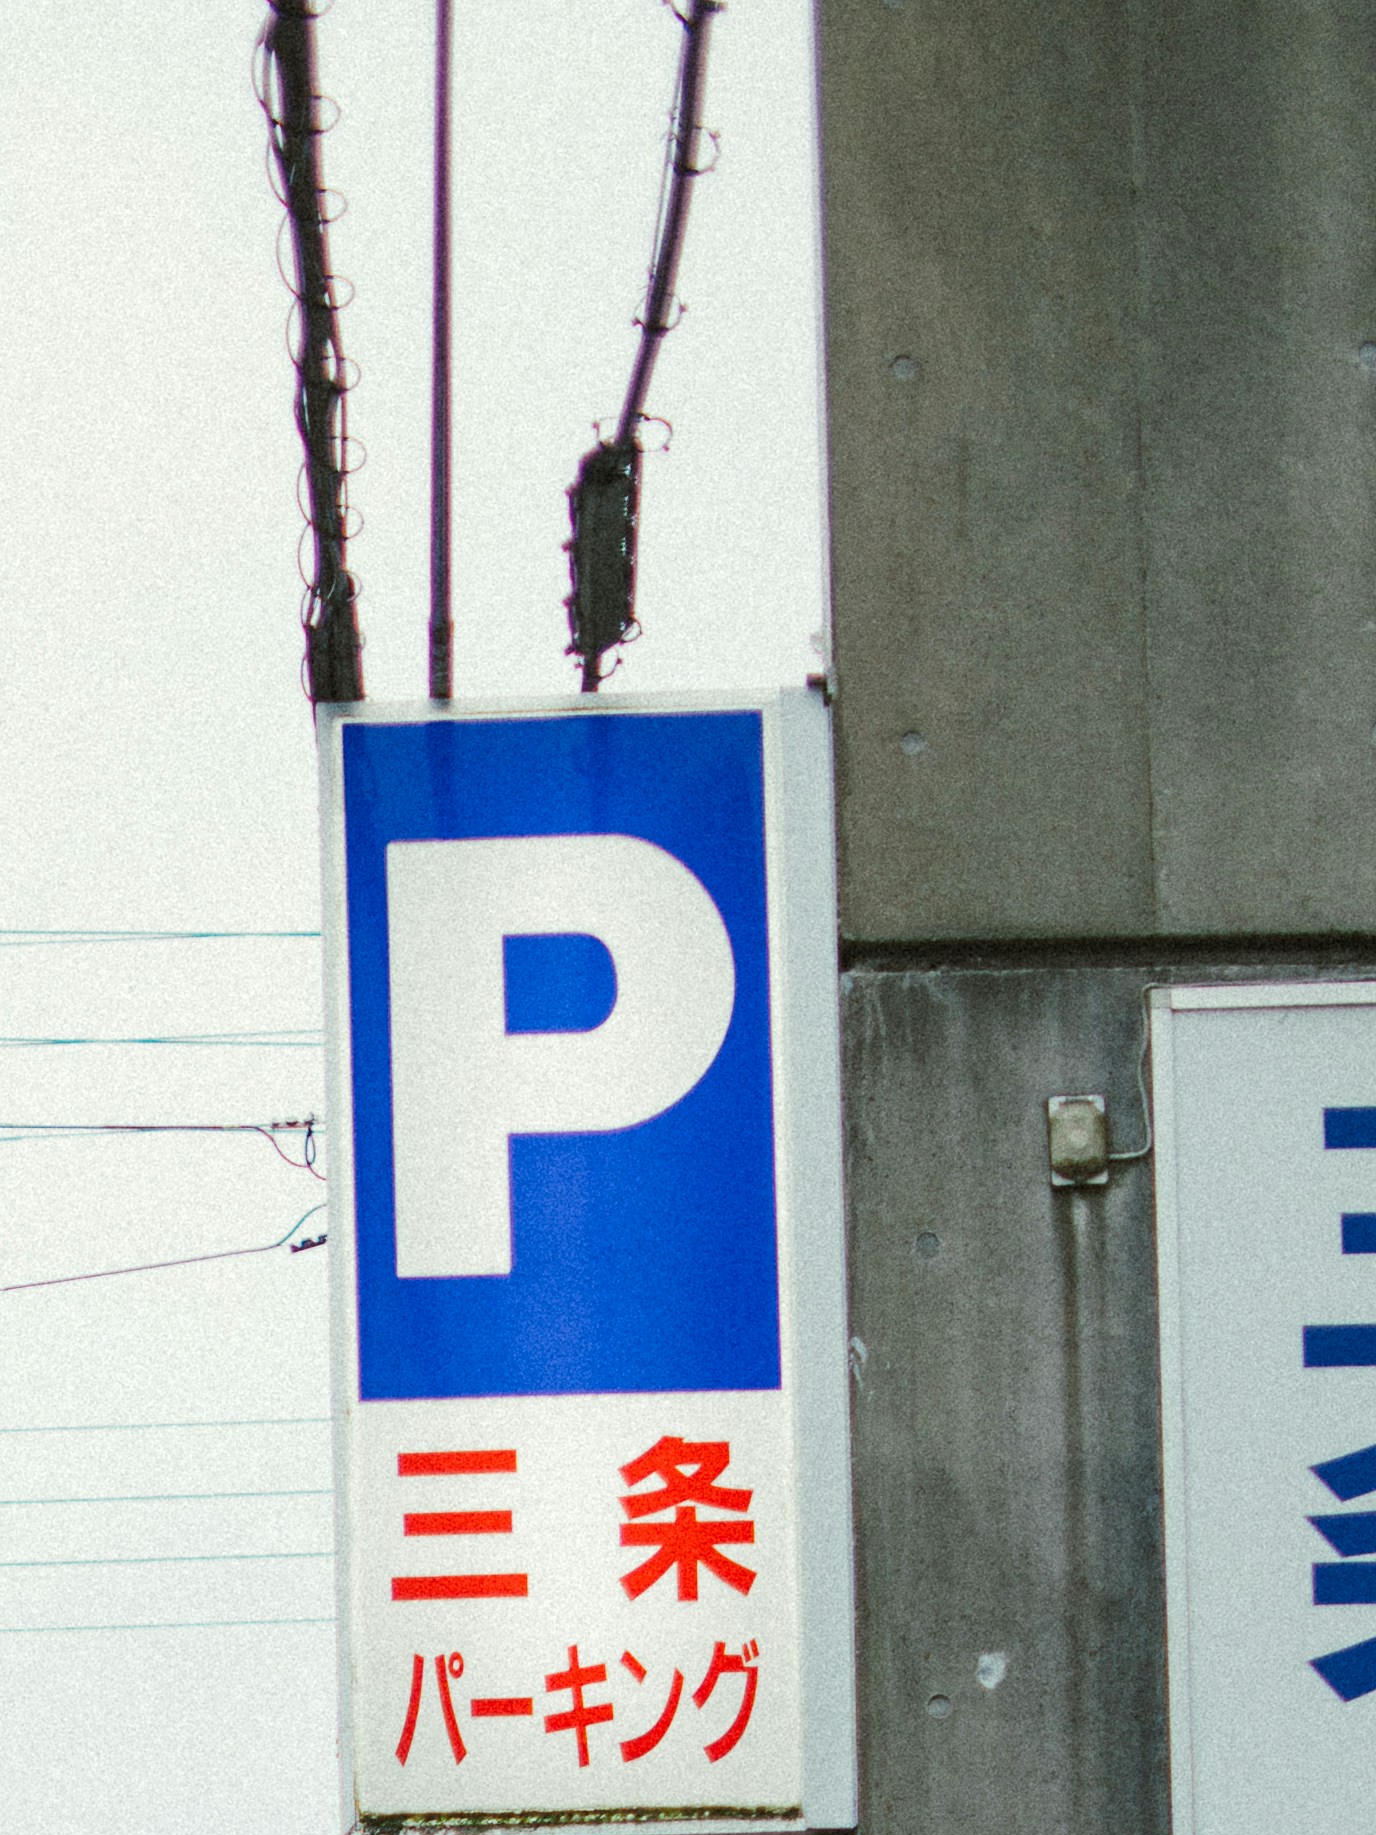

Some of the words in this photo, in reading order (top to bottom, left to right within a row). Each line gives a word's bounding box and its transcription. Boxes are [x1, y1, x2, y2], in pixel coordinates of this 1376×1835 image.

[386, 833, 736, 1278] P
[391, 1436, 758, 1601] 三条
[395, 1639, 760, 1768] パーキング
